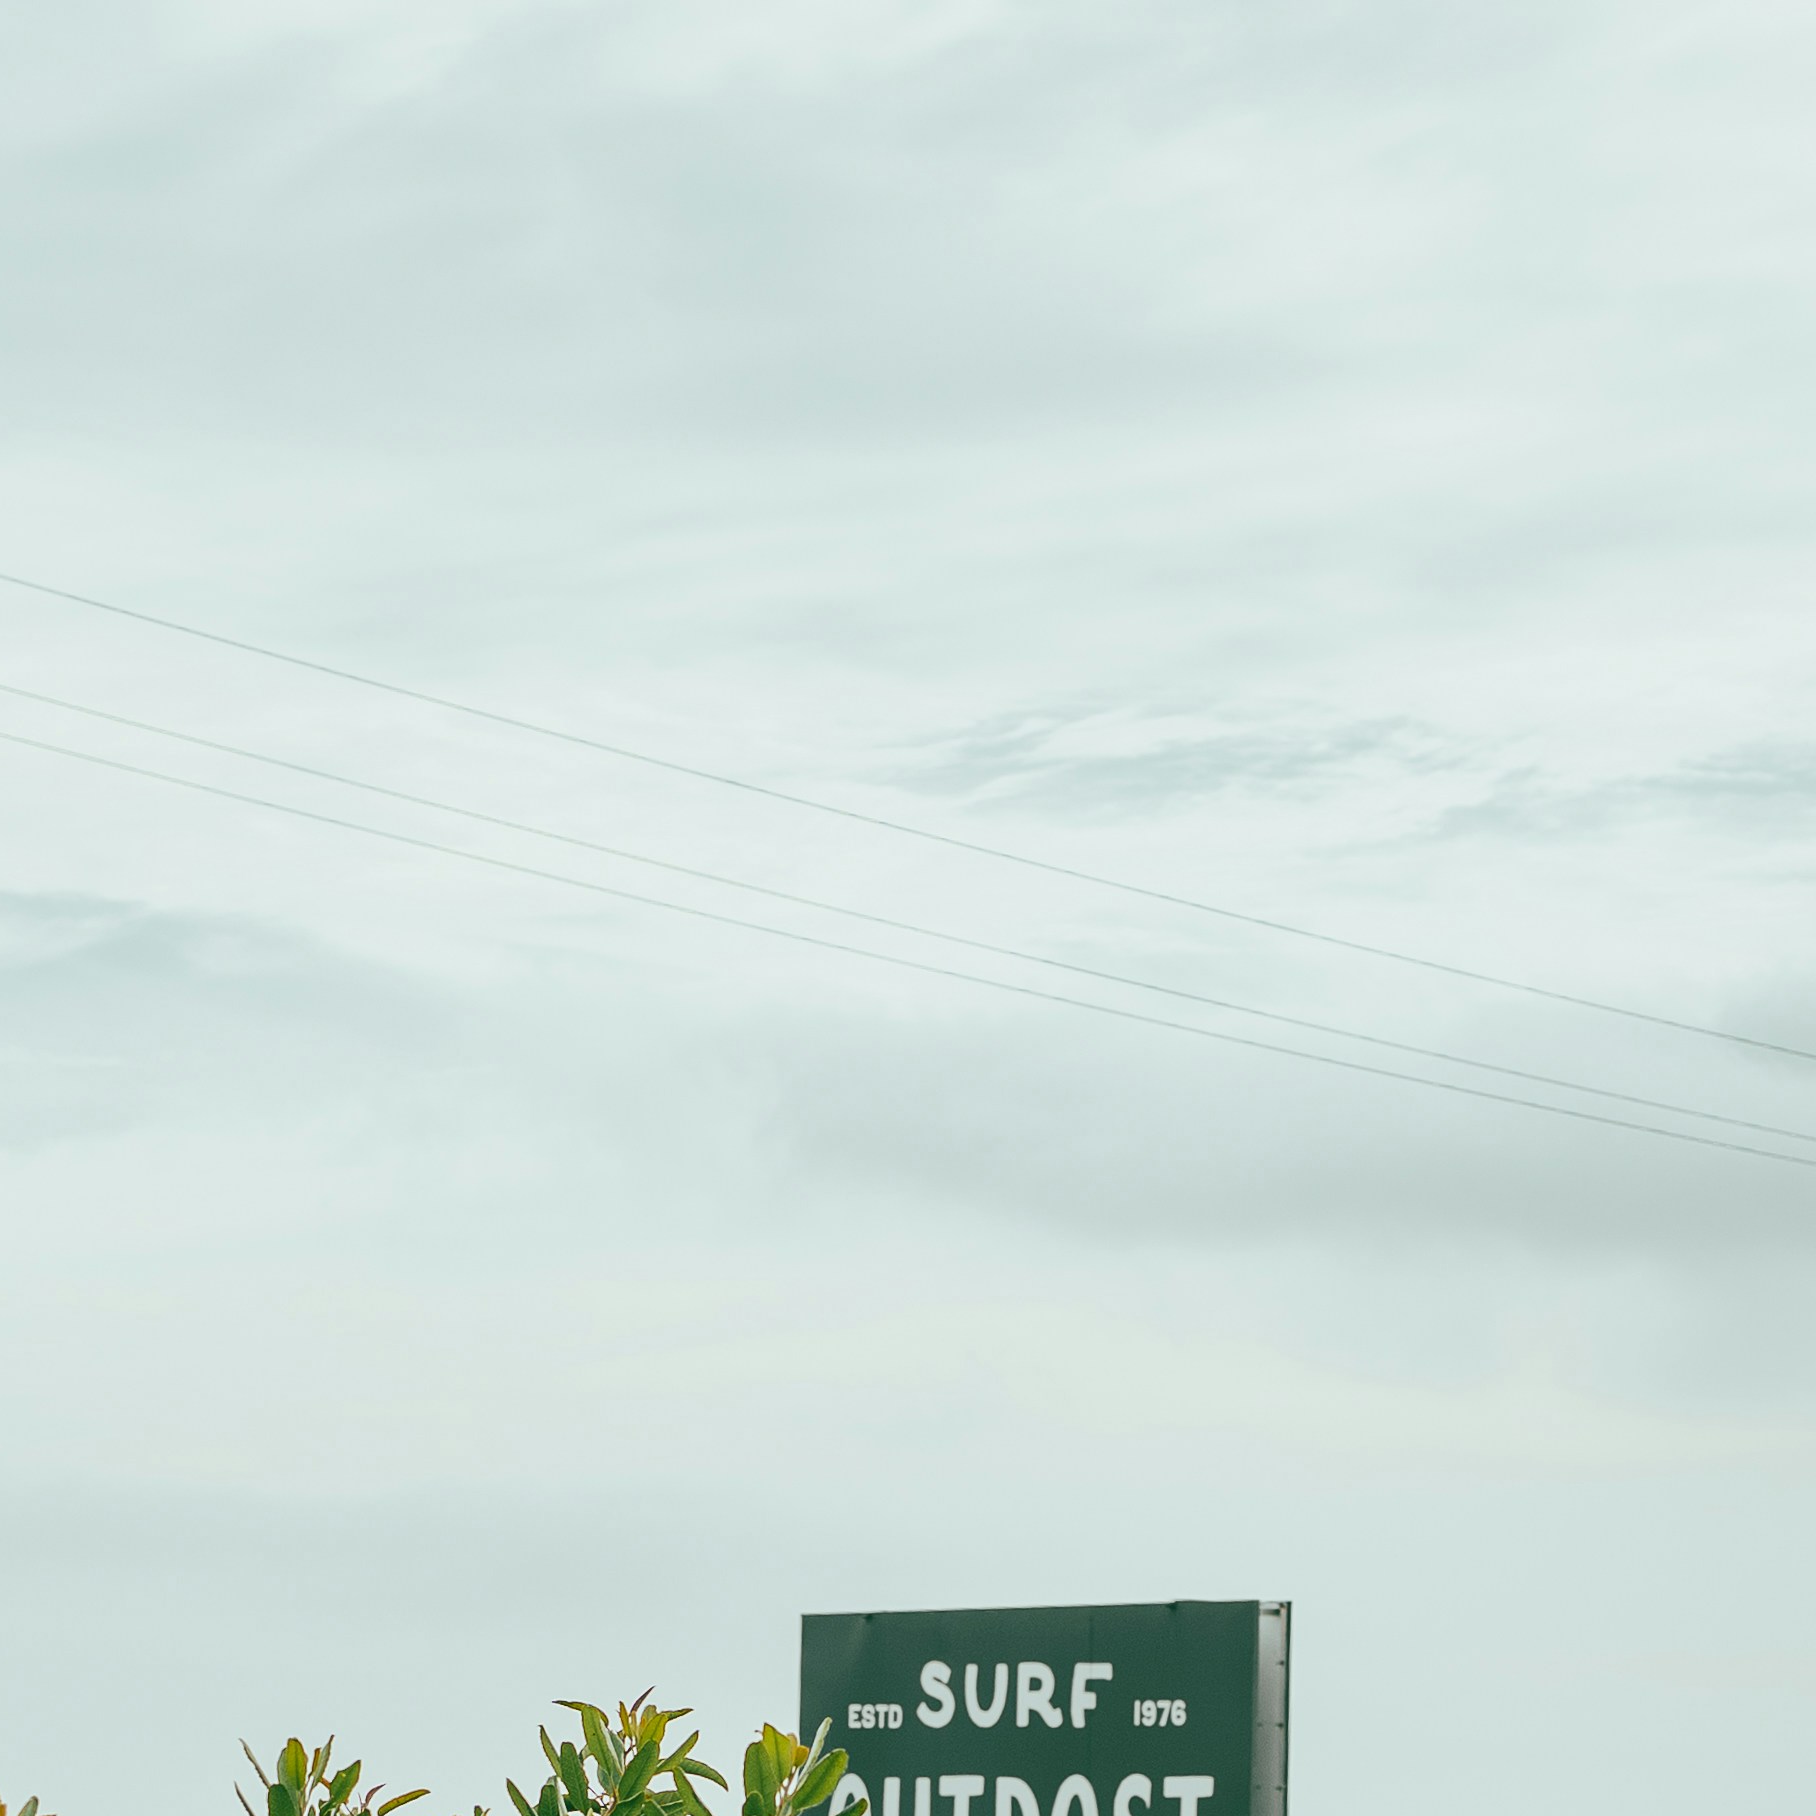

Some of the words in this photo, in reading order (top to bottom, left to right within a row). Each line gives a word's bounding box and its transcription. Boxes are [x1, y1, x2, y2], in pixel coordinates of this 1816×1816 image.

[847, 1703, 903, 1730] ESTD
[916, 1660, 1114, 1729] SURF
[1133, 1699, 1187, 1727] 1976
